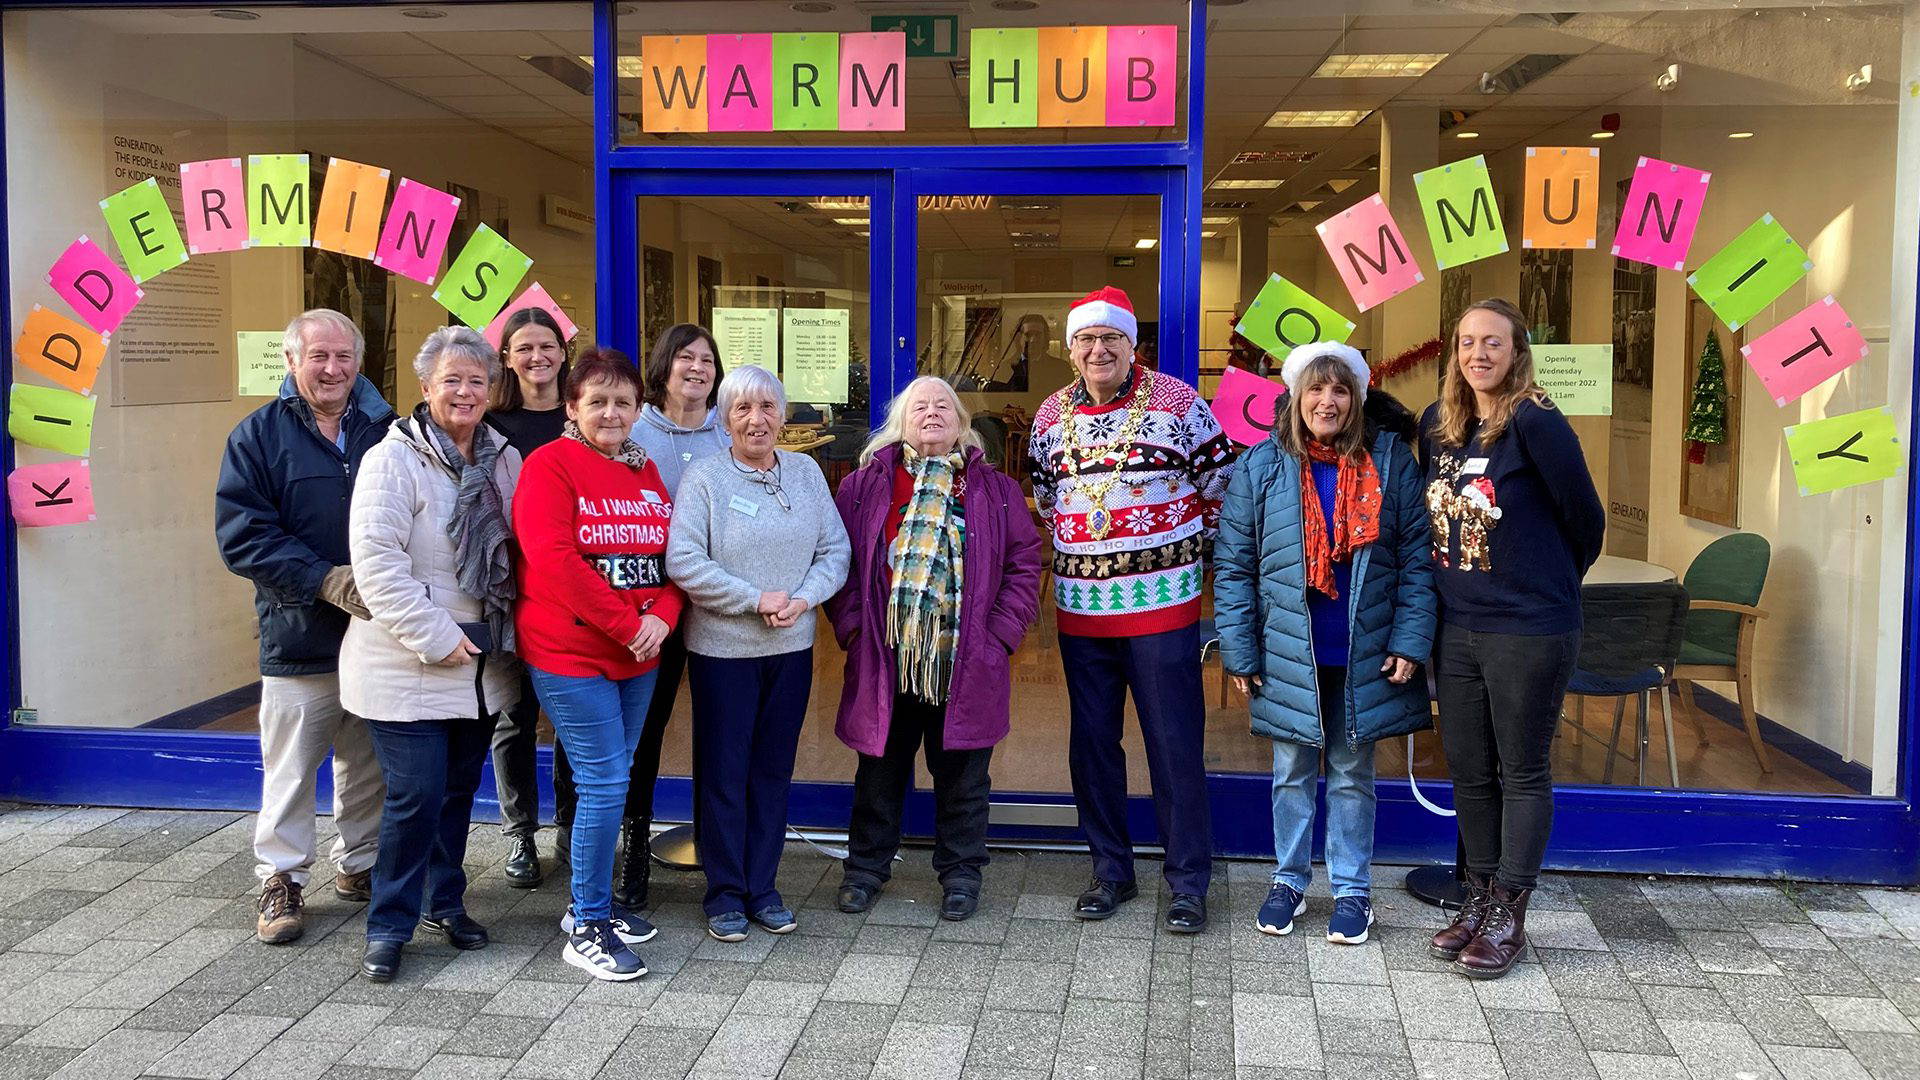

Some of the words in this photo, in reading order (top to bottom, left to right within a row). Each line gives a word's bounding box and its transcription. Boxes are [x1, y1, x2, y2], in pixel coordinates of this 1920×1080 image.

[652, 63, 899, 109] WARM
[988, 57, 1157, 103] HUB
[115, 152, 130, 164] THE
[132, 155, 159, 170] PEOPLE
[160, 162, 177, 173] AND
[115, 167, 126, 178] OF
[791, 318, 820, 326] Opening
[32, 181, 499, 507] KIDDERMINS
[1544, 355, 1577, 364] Opening
[1539, 368, 1582, 376] Wednesday
[579, 496, 603, 517] ALL
[602, 498, 611, 516] I
[609, 498, 653, 517] WANT
[579, 524, 665, 545] CHRISTMAS
[1080, 544, 1096, 552] HO
[1104, 540, 1125, 550] HO
[1134, 537, 1154, 547] HO
[1162, 532, 1177, 542] HO
[1182, 523, 1197, 534] HO
